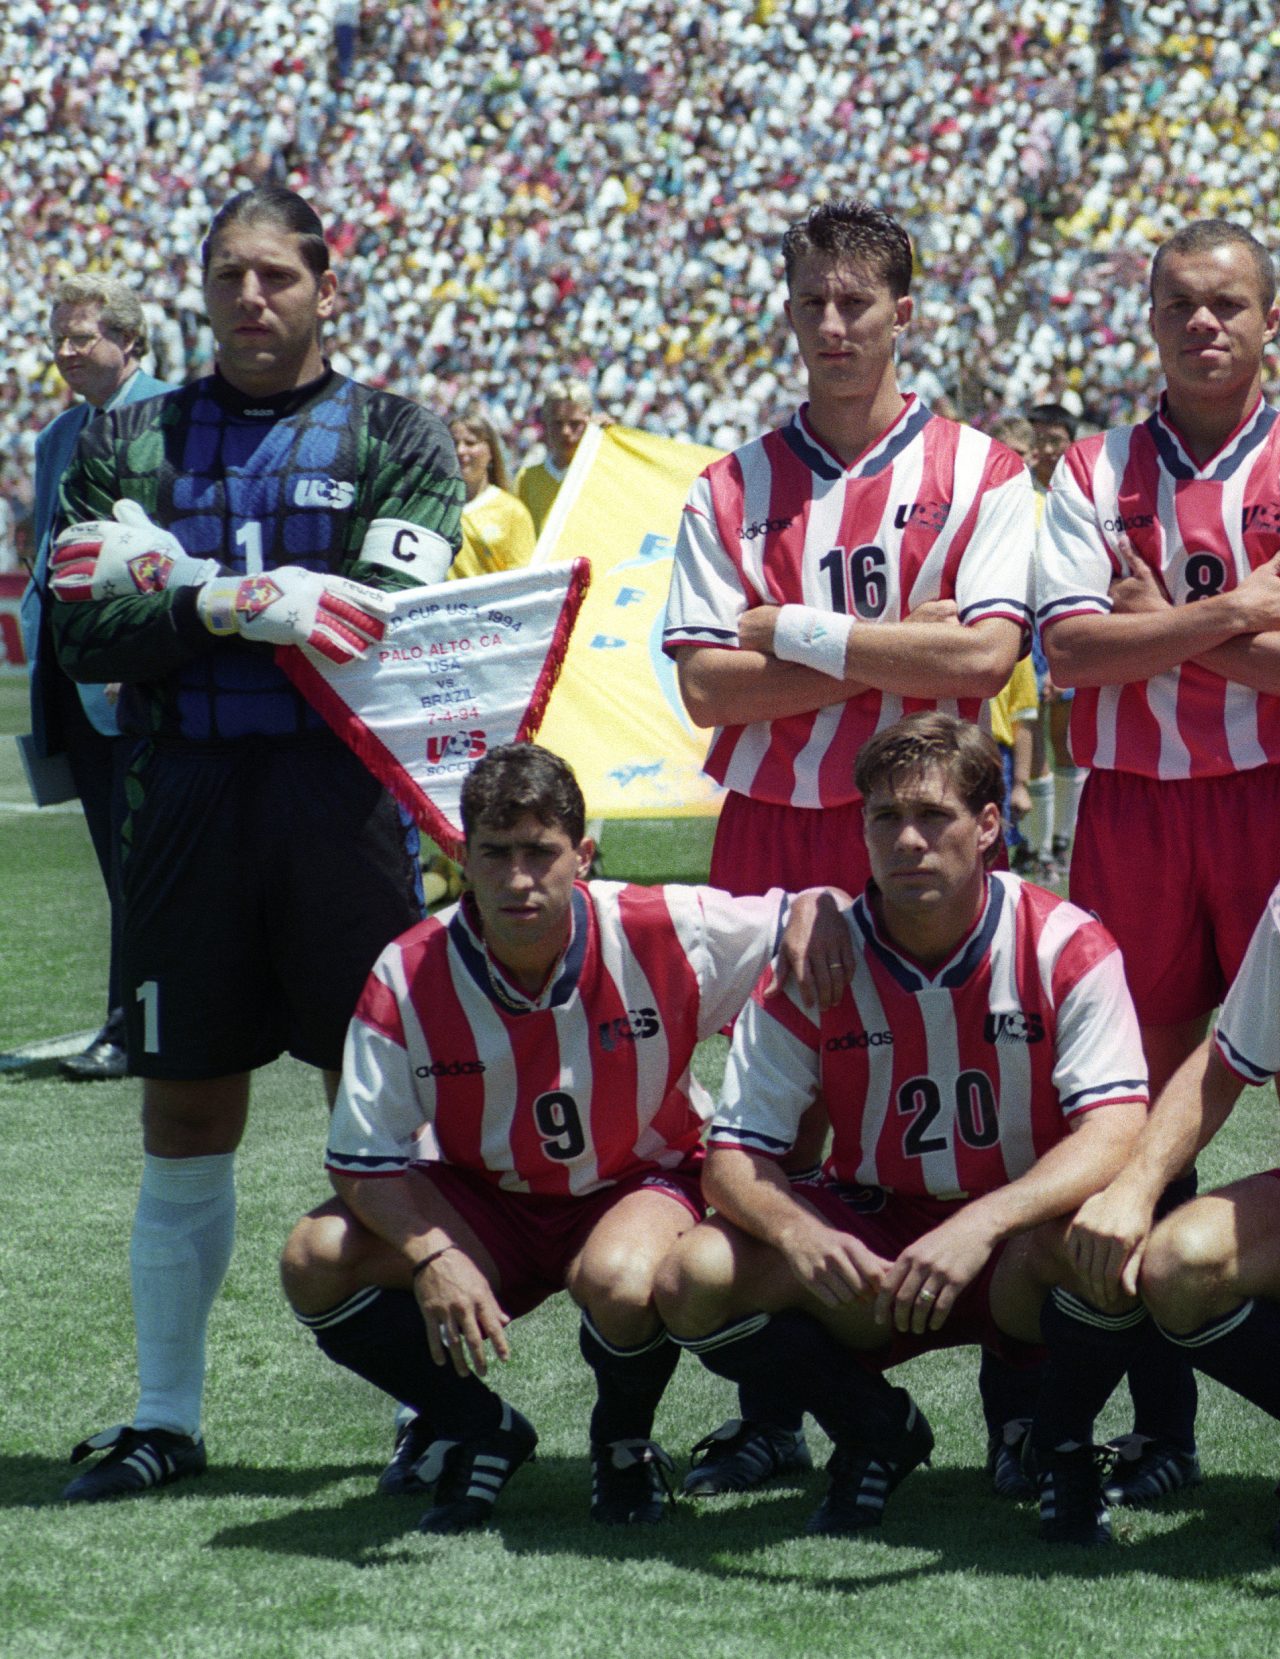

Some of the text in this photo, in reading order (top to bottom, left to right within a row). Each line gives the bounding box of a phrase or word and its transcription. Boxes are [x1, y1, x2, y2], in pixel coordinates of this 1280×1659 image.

[293, 478, 356, 510] US
[235, 521, 264, 575] 1
[392, 529, 420, 563] C
[818, 544, 888, 620] 16
[1185, 551, 1226, 605] 8
[407, 604, 441, 622] CUP
[487, 609, 523, 633] 1994
[379, 645, 424, 663] PALO
[479, 633, 503, 648] CA
[426, 659, 462, 675] USA
[420, 687, 477, 709] BRAZIL
[426, 706, 481, 726] 7-4-94
[426, 729, 488, 765] US
[135, 980, 160, 1054] 1
[599, 1006, 660, 1053] US
[983, 1010, 1045, 1045] US
[825, 1029, 894, 1051] adidas
[415, 1059, 486, 1079] adidas
[534, 1091, 586, 1161] 9
[897, 1069, 1000, 1158] 20
